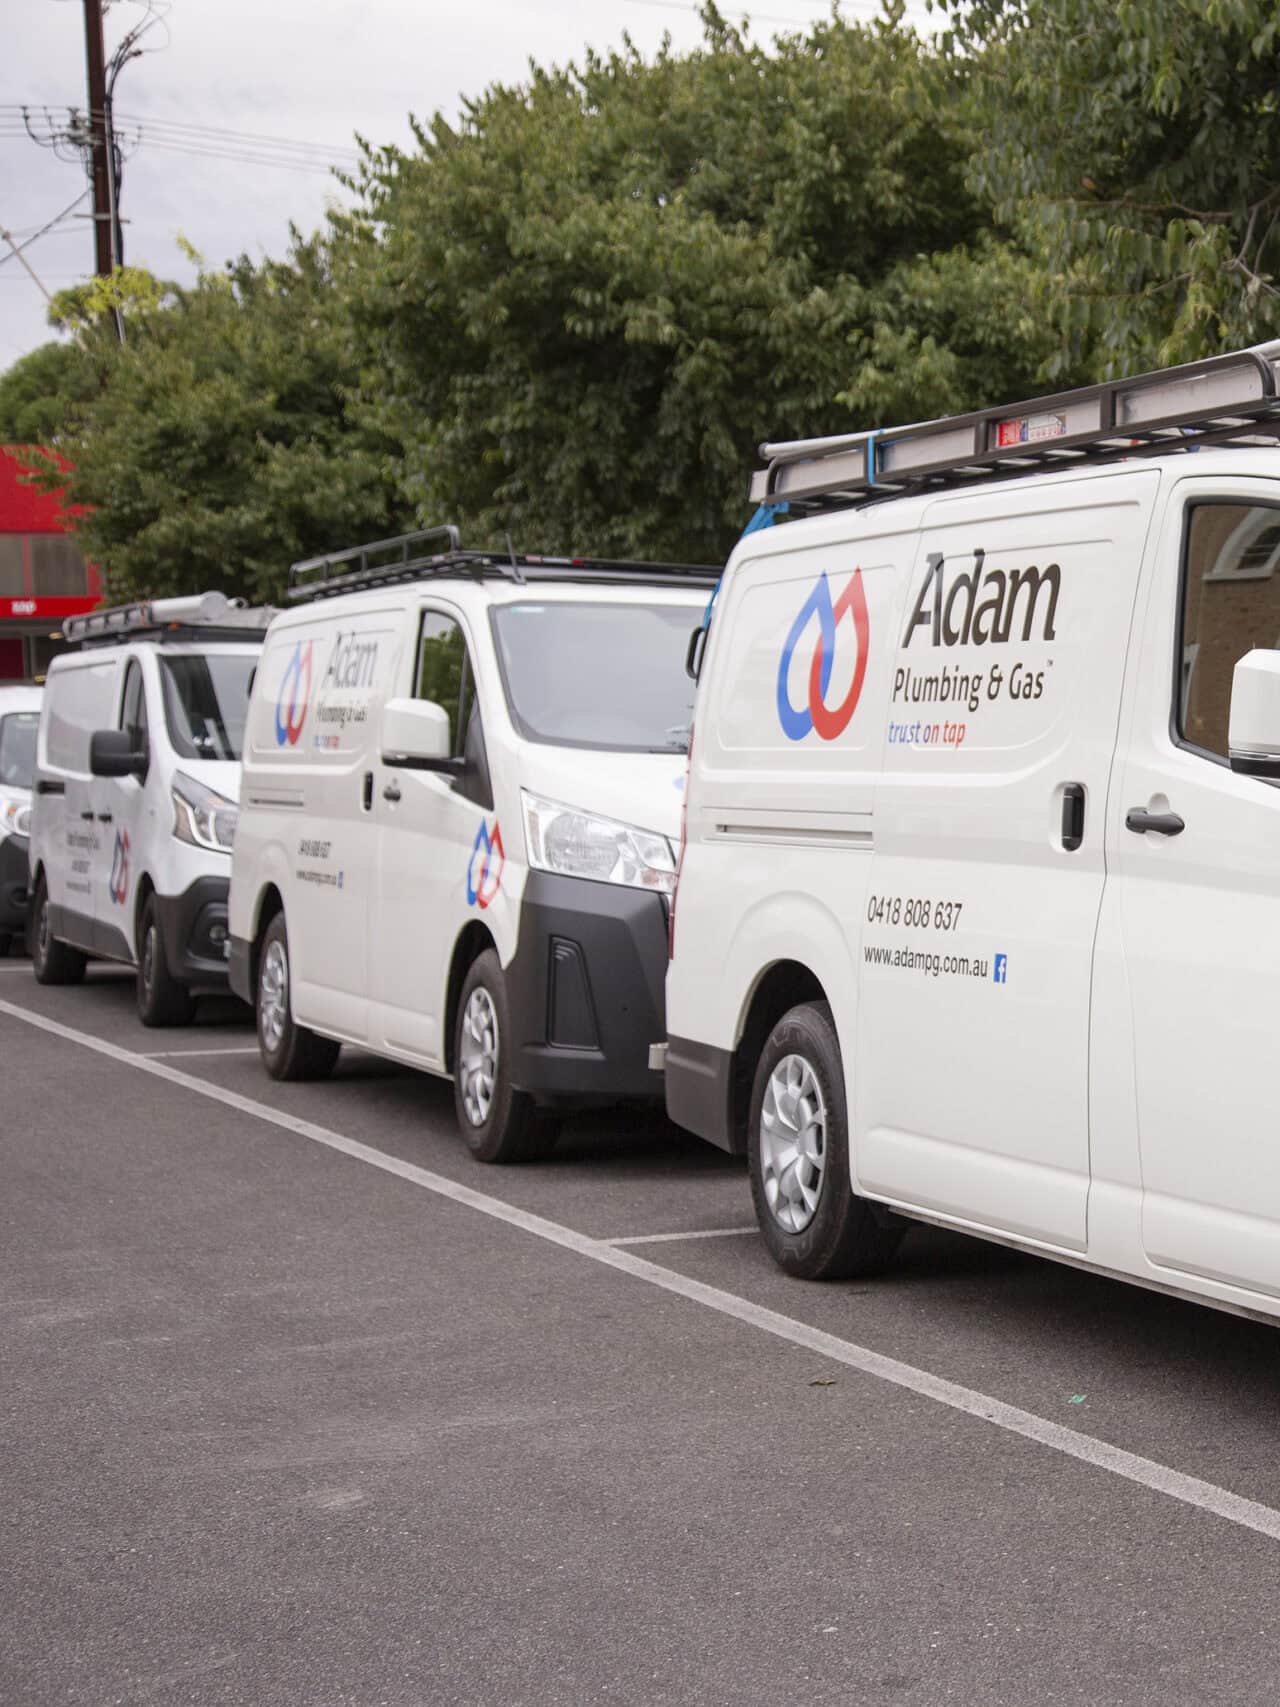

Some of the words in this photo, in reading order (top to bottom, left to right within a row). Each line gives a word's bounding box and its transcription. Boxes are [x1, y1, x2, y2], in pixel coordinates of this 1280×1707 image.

[901, 547, 1061, 649] Adam
[892, 666, 983, 713] Plumbing
[986, 663, 1004, 701] &
[1009, 662, 1045, 700] Gas
[888, 721, 921, 744] trust
[922, 724, 940, 744] on
[942, 719, 966, 748] tap
[867, 895, 902, 926] 0418
[903, 898, 931, 928] 808
[934, 901, 963, 931] 637
[864, 945, 989, 977] www.adampg.com.au
